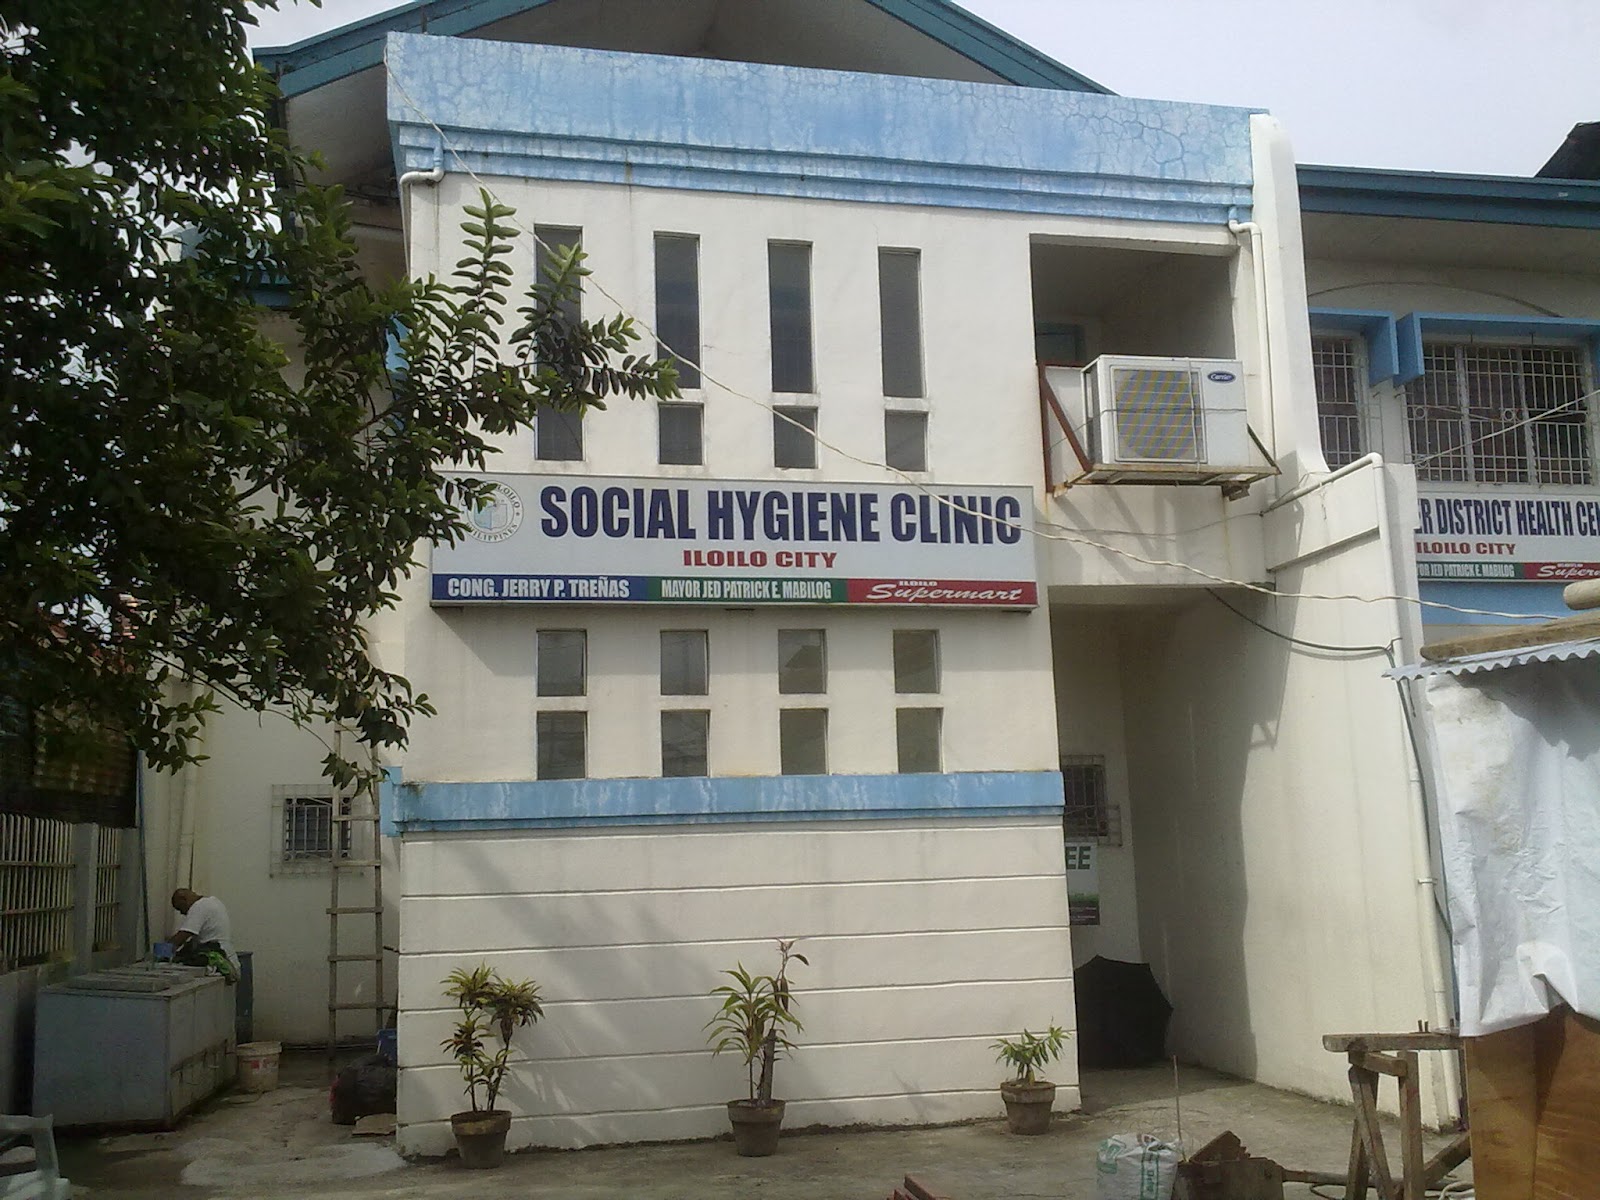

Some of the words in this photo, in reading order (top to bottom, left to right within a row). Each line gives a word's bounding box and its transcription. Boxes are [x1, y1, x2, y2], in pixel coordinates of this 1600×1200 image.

[540, 486, 697, 539] SOCIAL
[707, 490, 880, 543] HYGIENE
[890, 492, 1022, 545] CLINIC
[1435, 499, 1512, 536] DISTRICT
[1515, 500, 1574, 536] HEALTH
[1416, 541, 1471, 555] ILOILO
[1475, 542, 1516, 555] CITY
[683, 550, 768, 568] ILOILO
[775, 551, 838, 569] CITY
[1444, 563, 1475, 577] PATRICK
[448, 578, 499, 597] CONG.
[502, 578, 550, 598] JERRY
[553, 579, 566, 598] P.
[569, 576, 630, 598] TREÑAS
[661, 579, 701, 598] MAYOR
[702, 580, 722, 598] JED
[724, 580, 774, 599] PATRICK
[772, 581, 782, 599] E.
[782, 581, 832, 599] MABILOG
[866, 583, 1023, 602] Supermart
